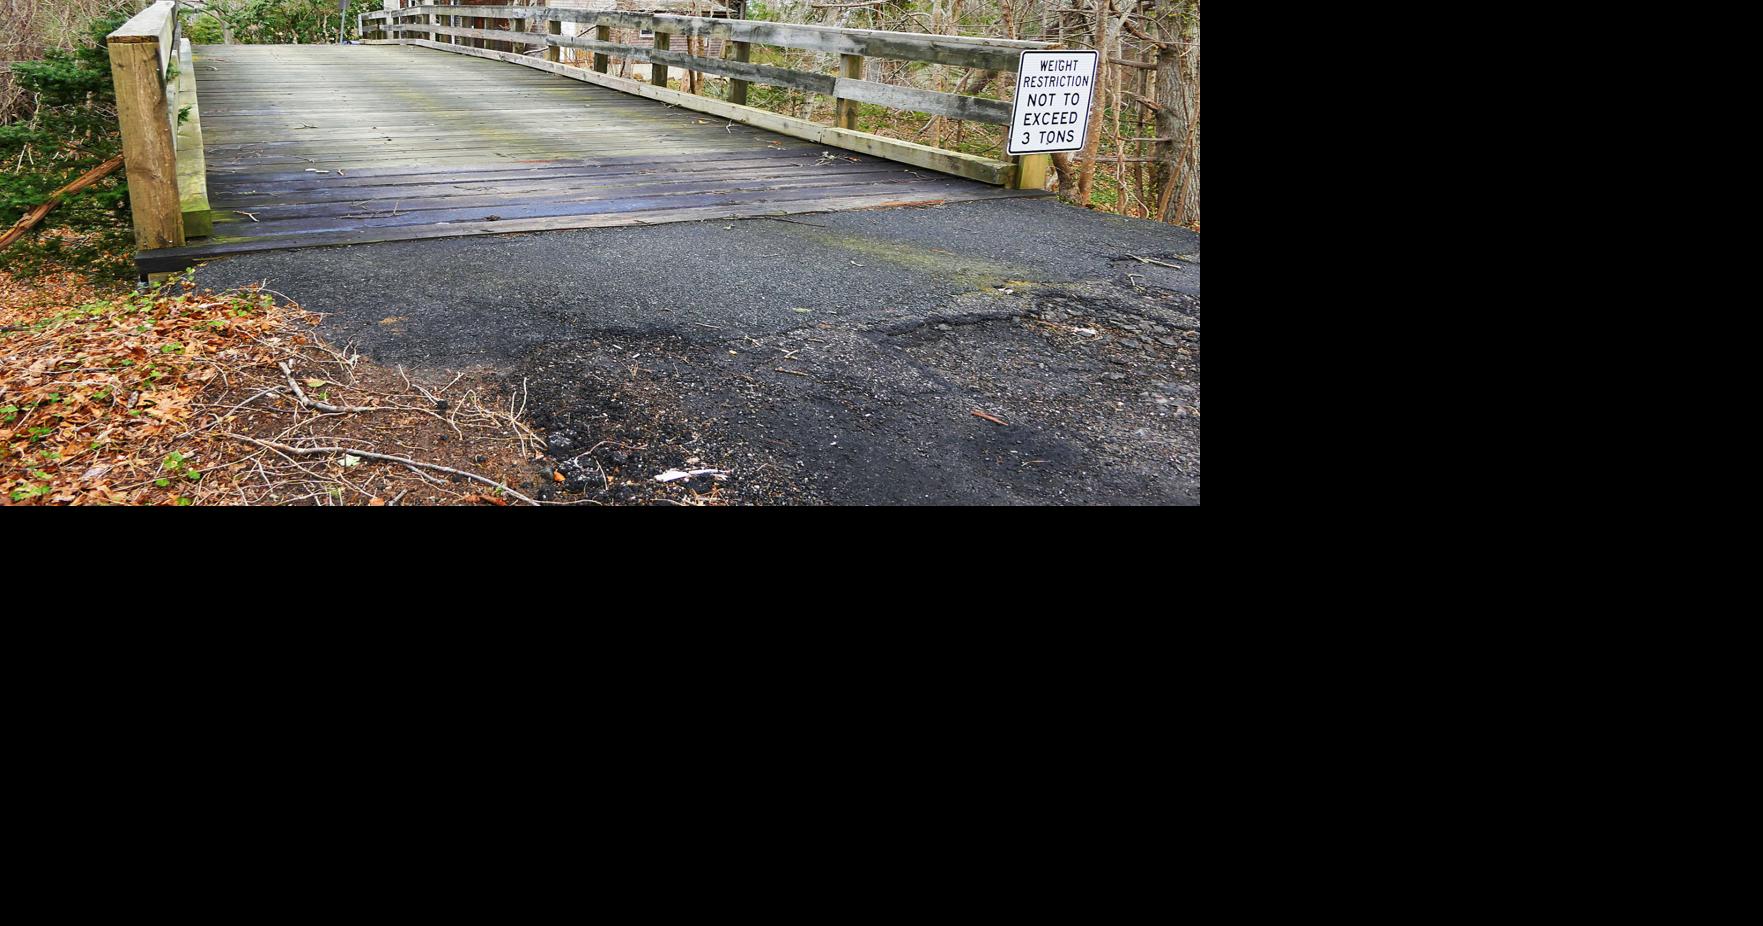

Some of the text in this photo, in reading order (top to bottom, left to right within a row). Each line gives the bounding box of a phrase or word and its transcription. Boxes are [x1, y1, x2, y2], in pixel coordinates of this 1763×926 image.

[1040, 60, 1079, 71] WEIGHT
[1023, 75, 1089, 88] RESTRICTION
[1027, 92, 1080, 107] NOT TO
[1023, 111, 1078, 126] EXCEED
[1021, 130, 1074, 145] 3 TONS
